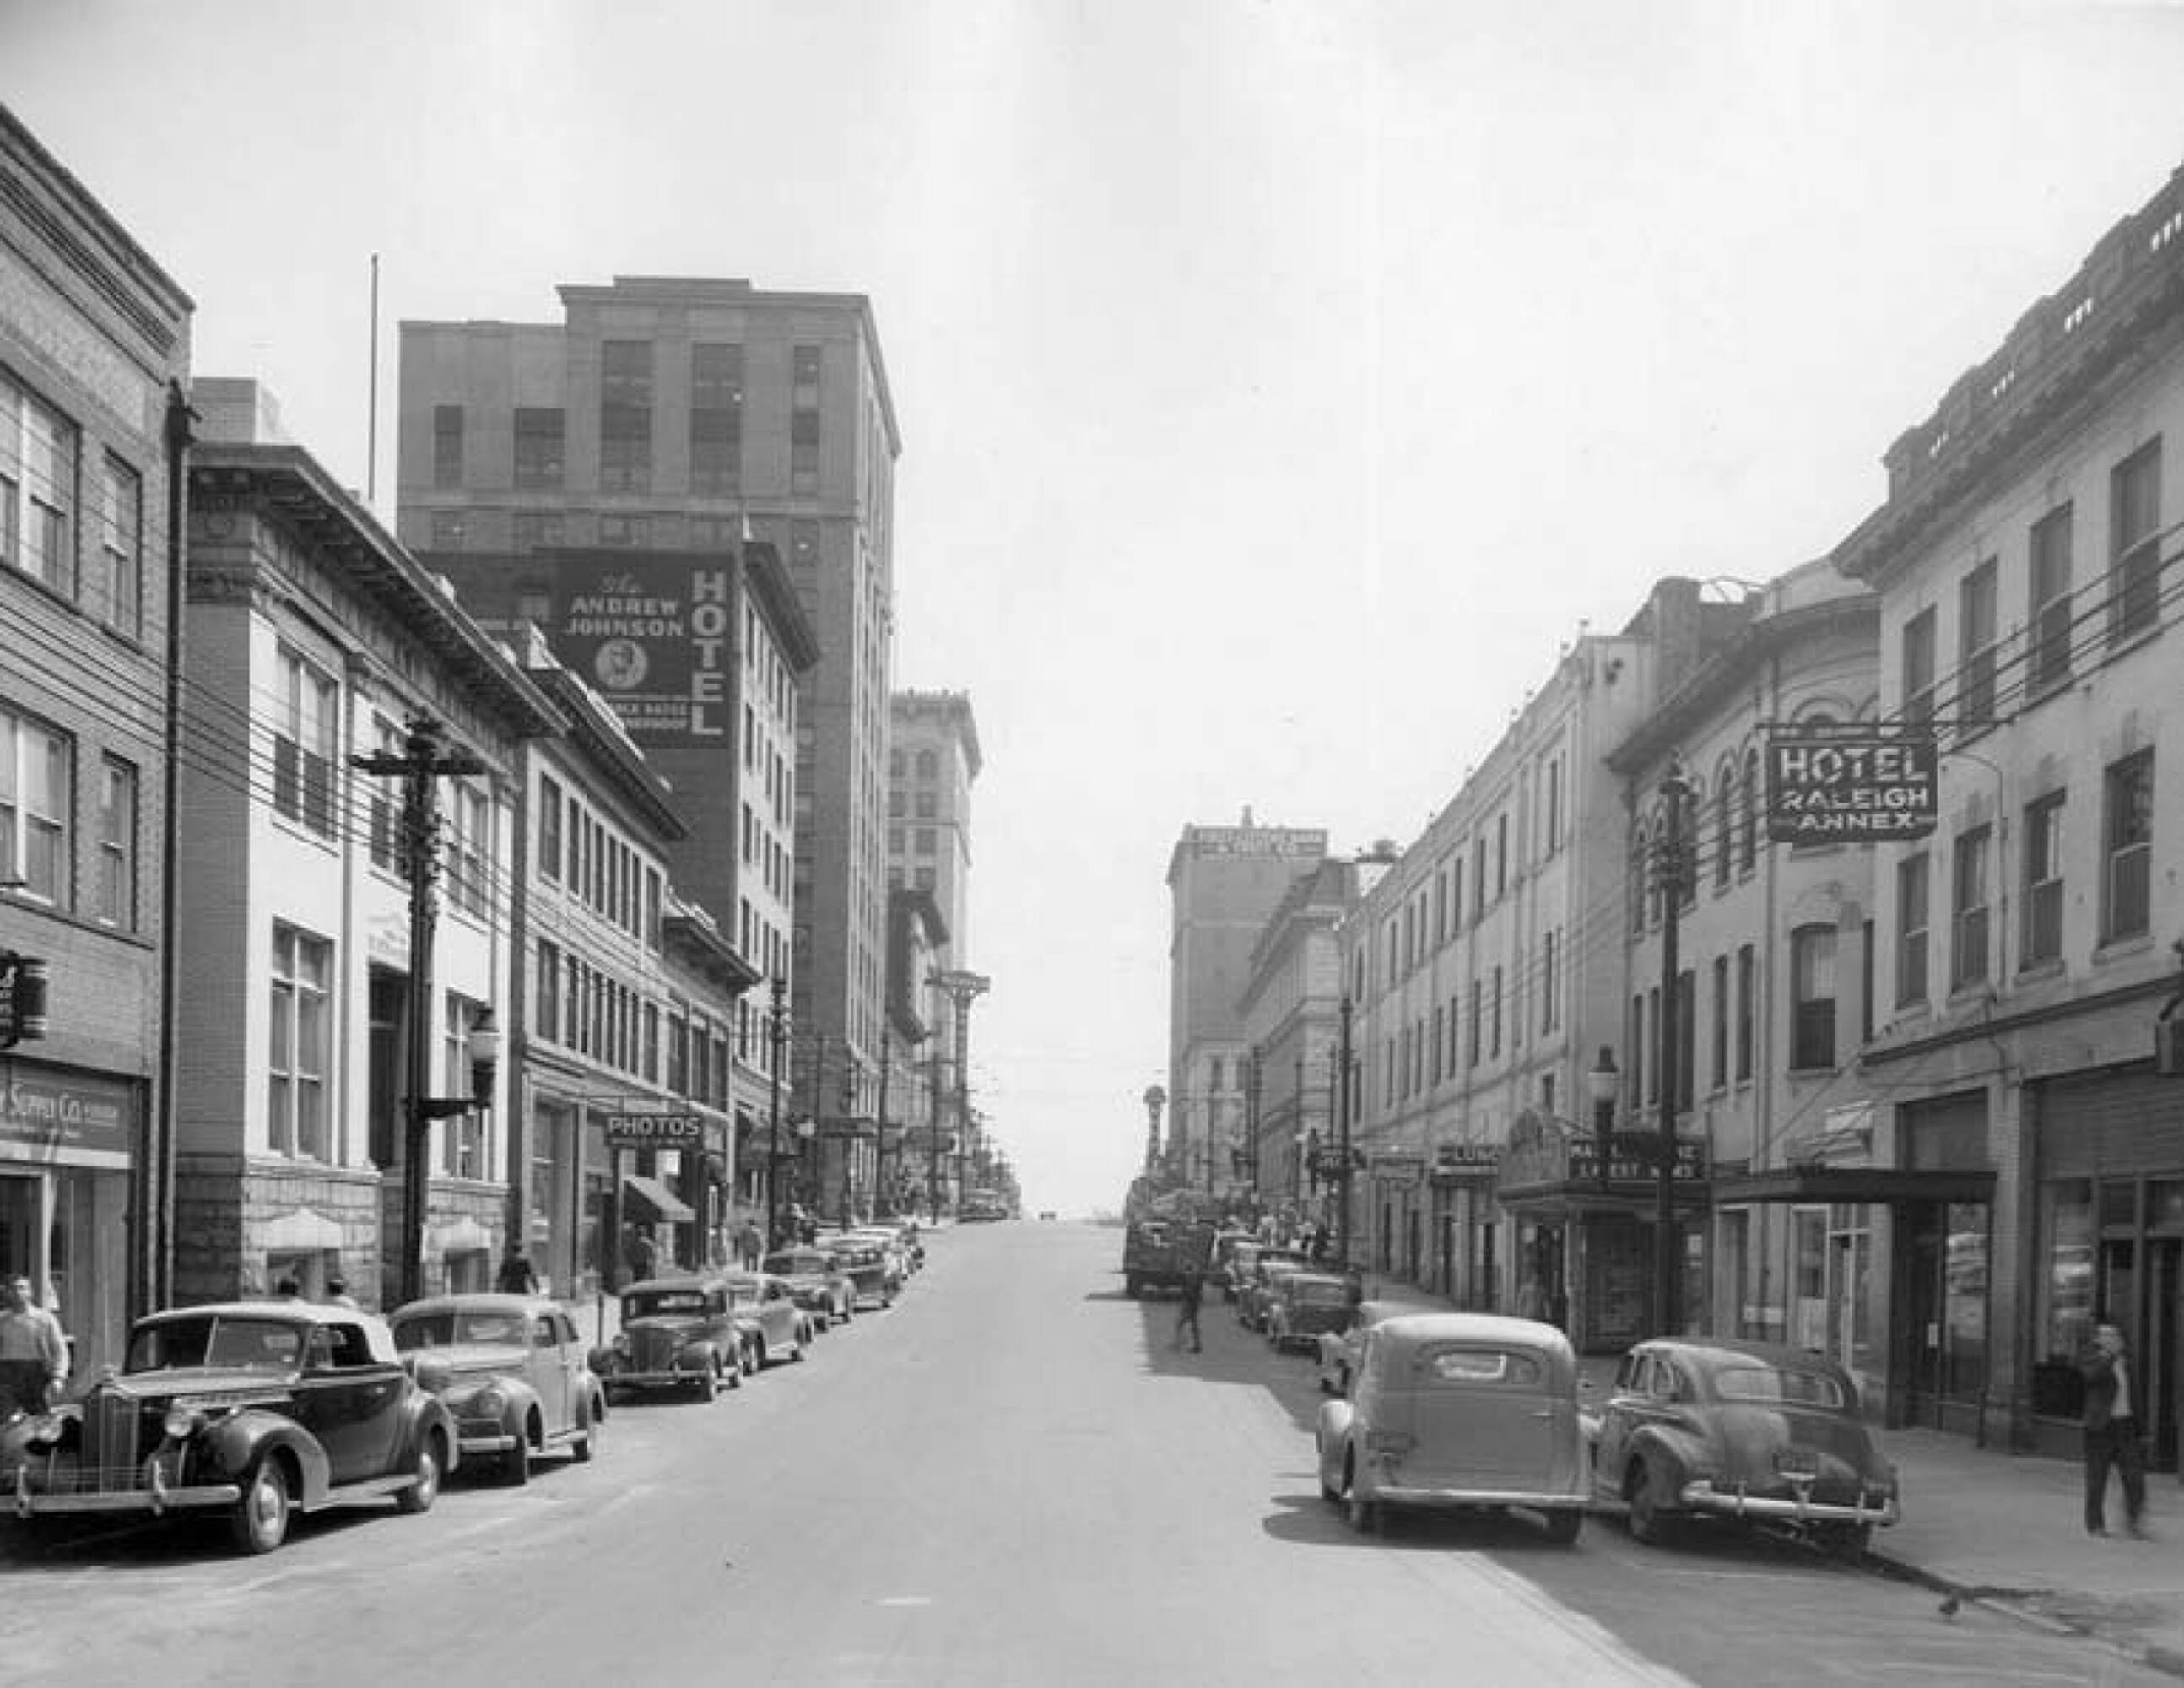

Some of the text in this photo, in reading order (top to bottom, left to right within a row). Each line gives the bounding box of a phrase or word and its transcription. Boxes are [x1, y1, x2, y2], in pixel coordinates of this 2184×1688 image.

[569, 596, 678, 617] ANDREW
[565, 618, 684, 636] JOHNSON
[690, 570, 727, 736] HOTEL
[1780, 747, 1930, 784] HOTEL
[1781, 787, 1930, 810] RALEIGH
[1797, 813, 1915, 831] ANNEX
[608, 1117, 700, 1136] PHOTOS
